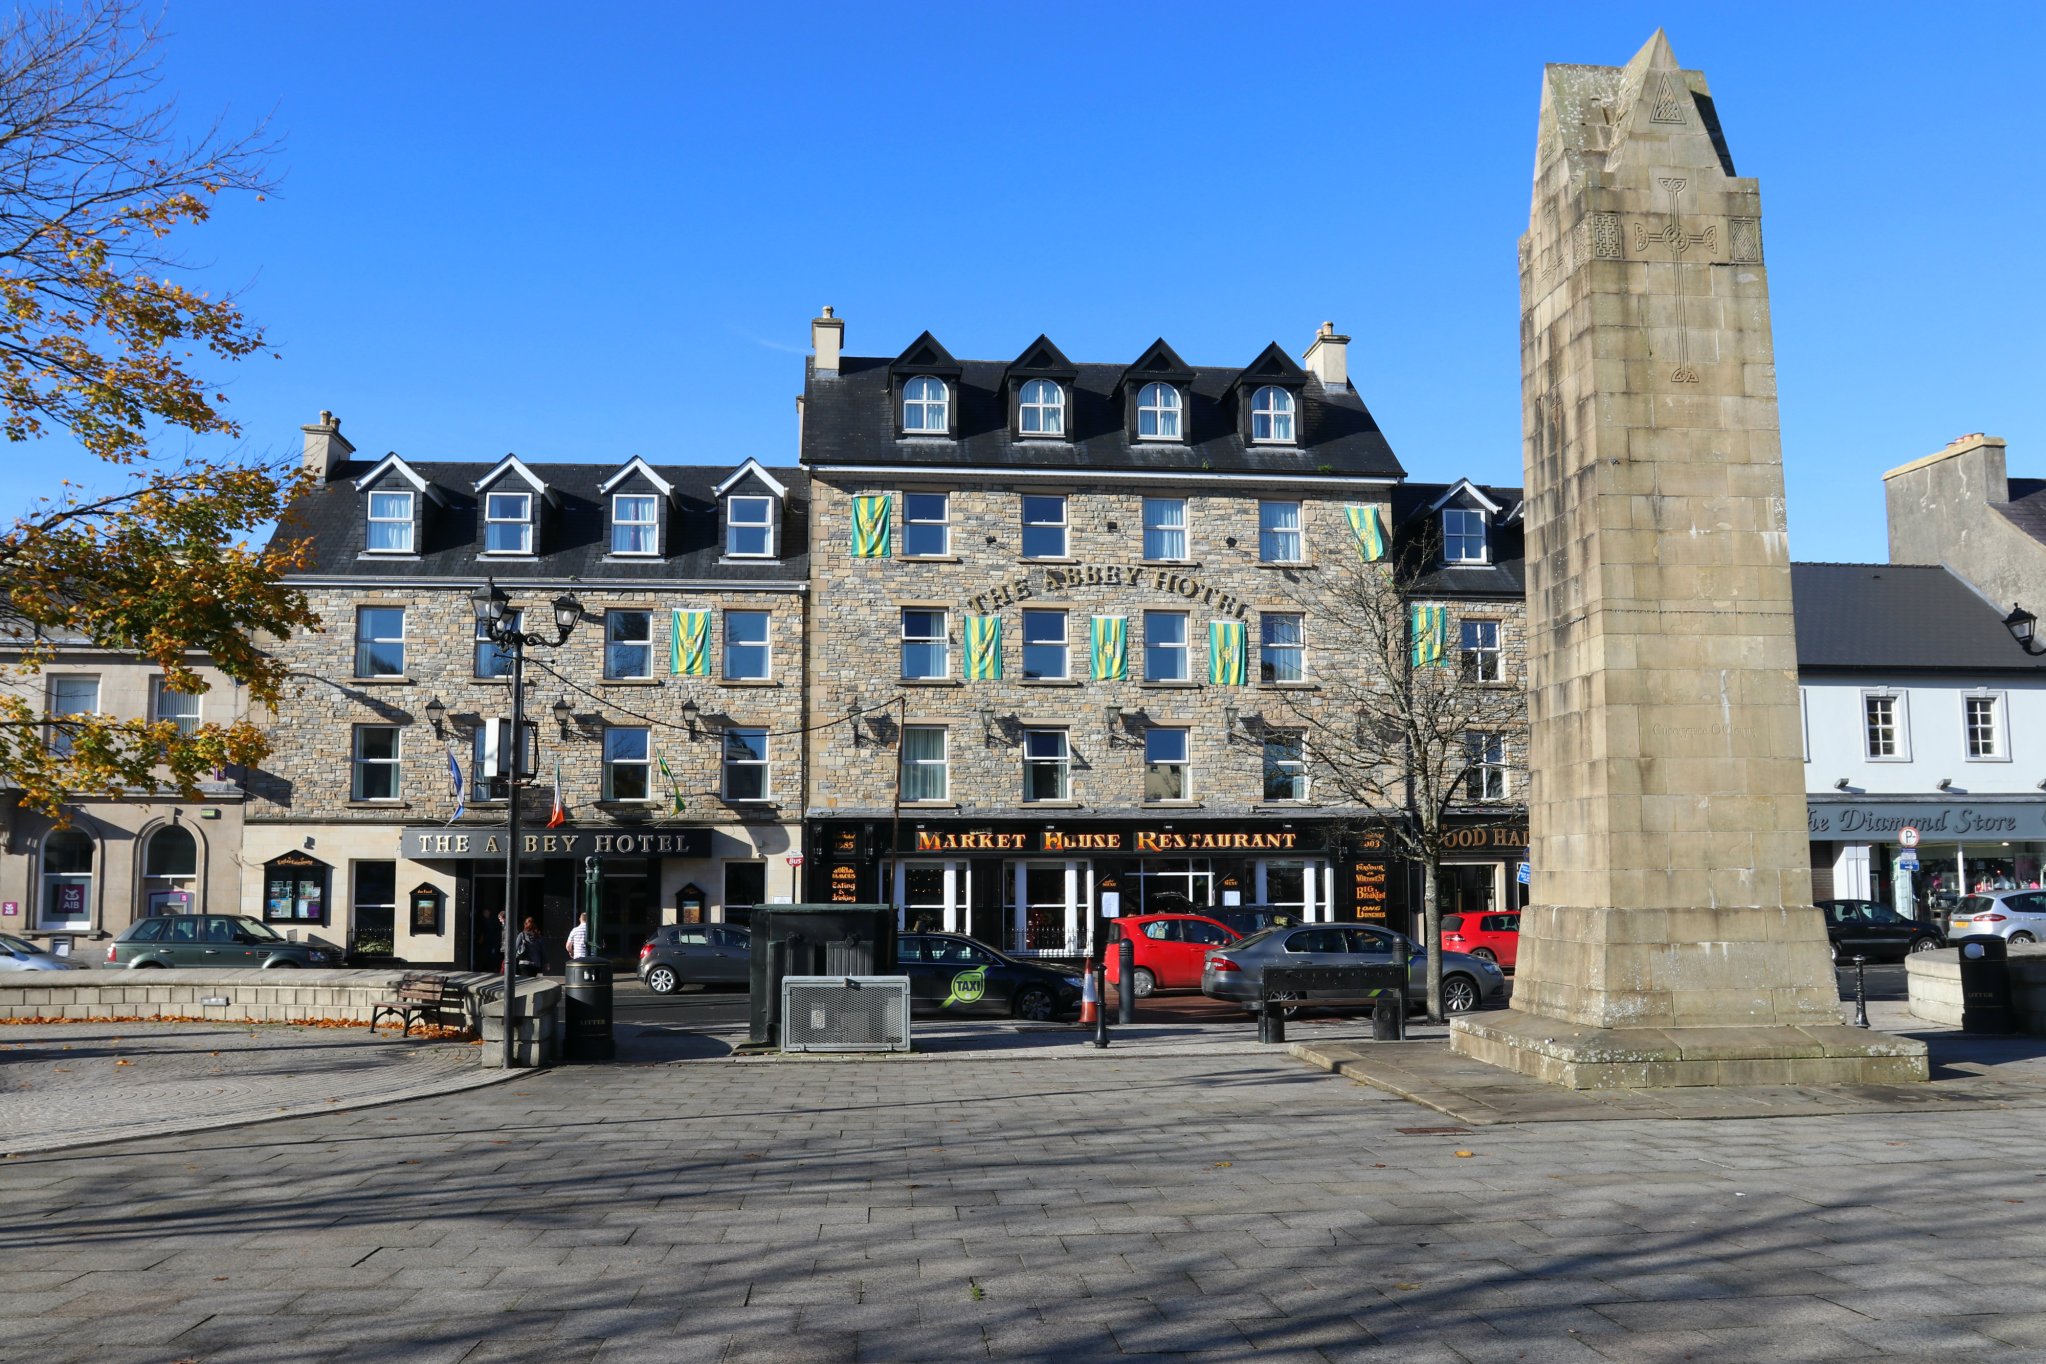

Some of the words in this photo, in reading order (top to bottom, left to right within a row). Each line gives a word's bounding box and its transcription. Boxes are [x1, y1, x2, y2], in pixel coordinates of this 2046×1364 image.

[967, 580, 1029, 614] THE
[1043, 565, 1141, 590] ABBEY
[1154, 569, 1246, 619] HOTEL
[1807, 809, 1829, 831] he
[1839, 809, 1950, 832] Diamond
[1953, 809, 2016, 833] Store
[419, 835, 469, 852] THE
[485, 835, 578, 852] ABEY
[595, 835, 690, 853] HOTEL
[918, 831, 1026, 850] MARKET
[1043, 831, 1121, 850] HOUSE
[1137, 831, 1296, 852] RESTAURANT
[1440, 829, 1487, 847] OOD
[64, 901, 79, 909] AIB
[956, 980, 980, 991] TAXI
